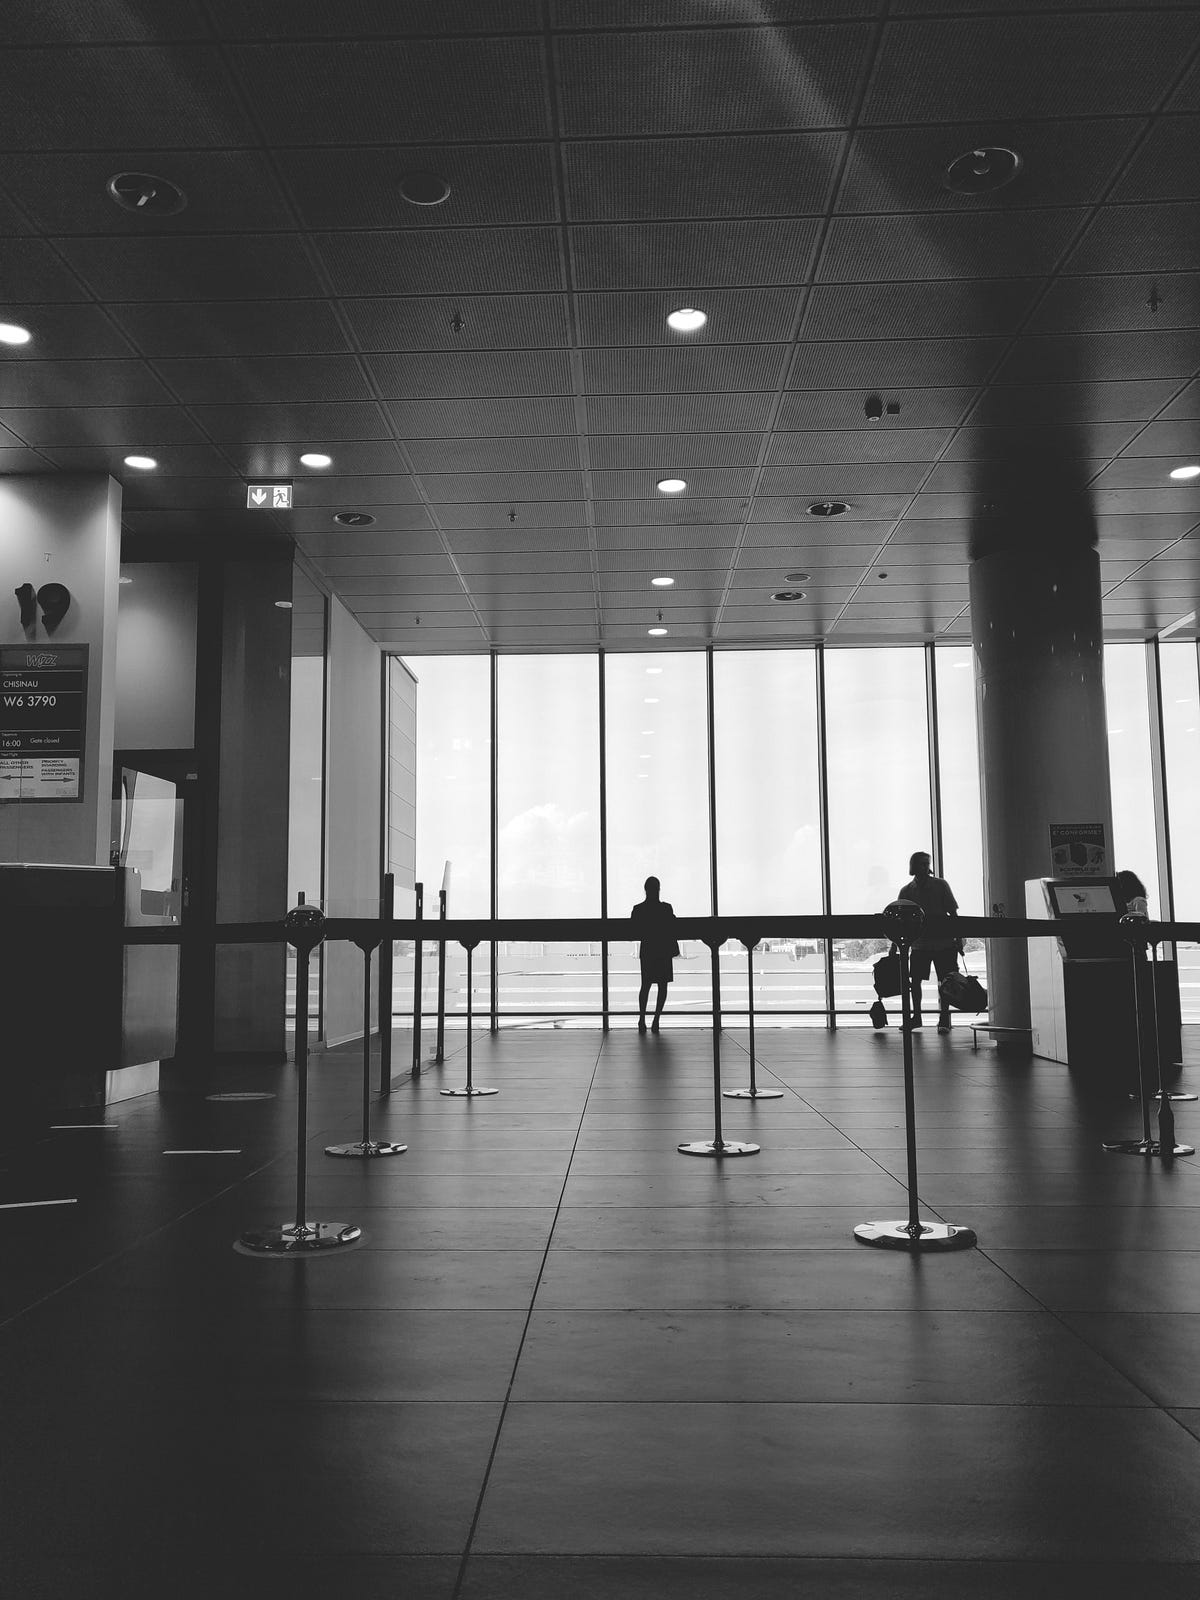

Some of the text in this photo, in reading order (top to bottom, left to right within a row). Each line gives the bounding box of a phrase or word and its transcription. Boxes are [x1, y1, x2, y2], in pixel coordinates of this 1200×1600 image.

[3, 680, 39, 688] CHISINAU
[3, 695, 57, 707] W6 3790
[2, 739, 21, 747] 16:00
